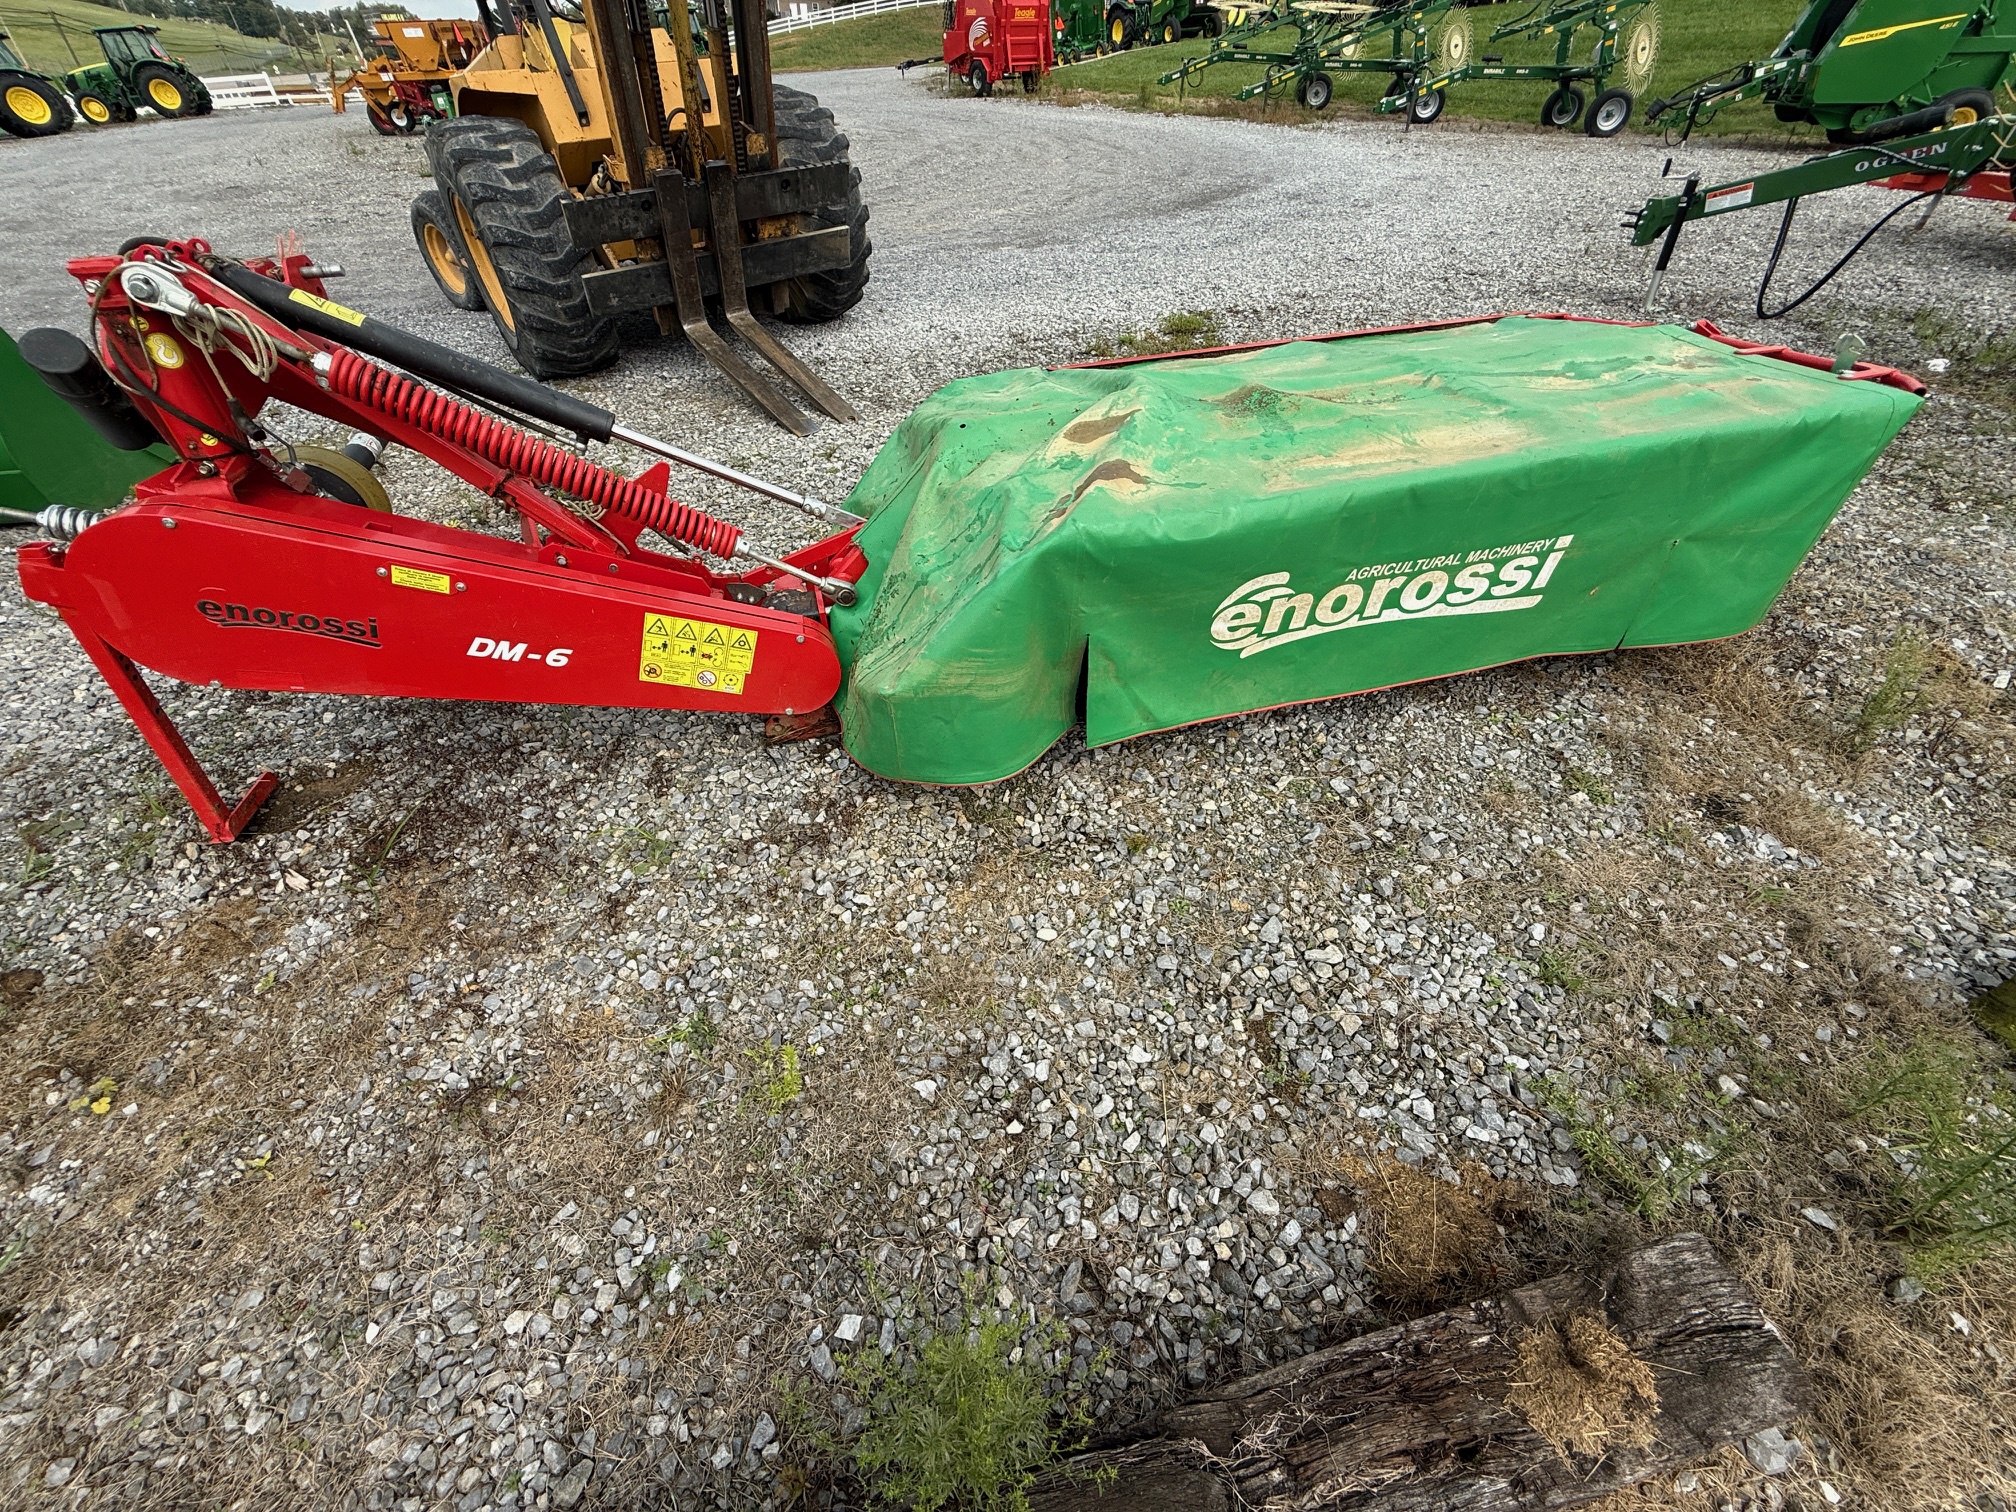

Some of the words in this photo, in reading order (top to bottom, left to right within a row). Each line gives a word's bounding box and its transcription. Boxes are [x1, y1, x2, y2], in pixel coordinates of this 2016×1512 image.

[1014, 7, 1036, 18] Teagle
[1865, 30, 1888, 39] DEERE
[1345, 553, 1461, 582] AGRICULTURAL
[1465, 537, 1557, 566] MACHINERY
[1210, 534, 1575, 642] enorossi
[196, 598, 380, 640] enorossi
[466, 636, 574, 668] DM-6
